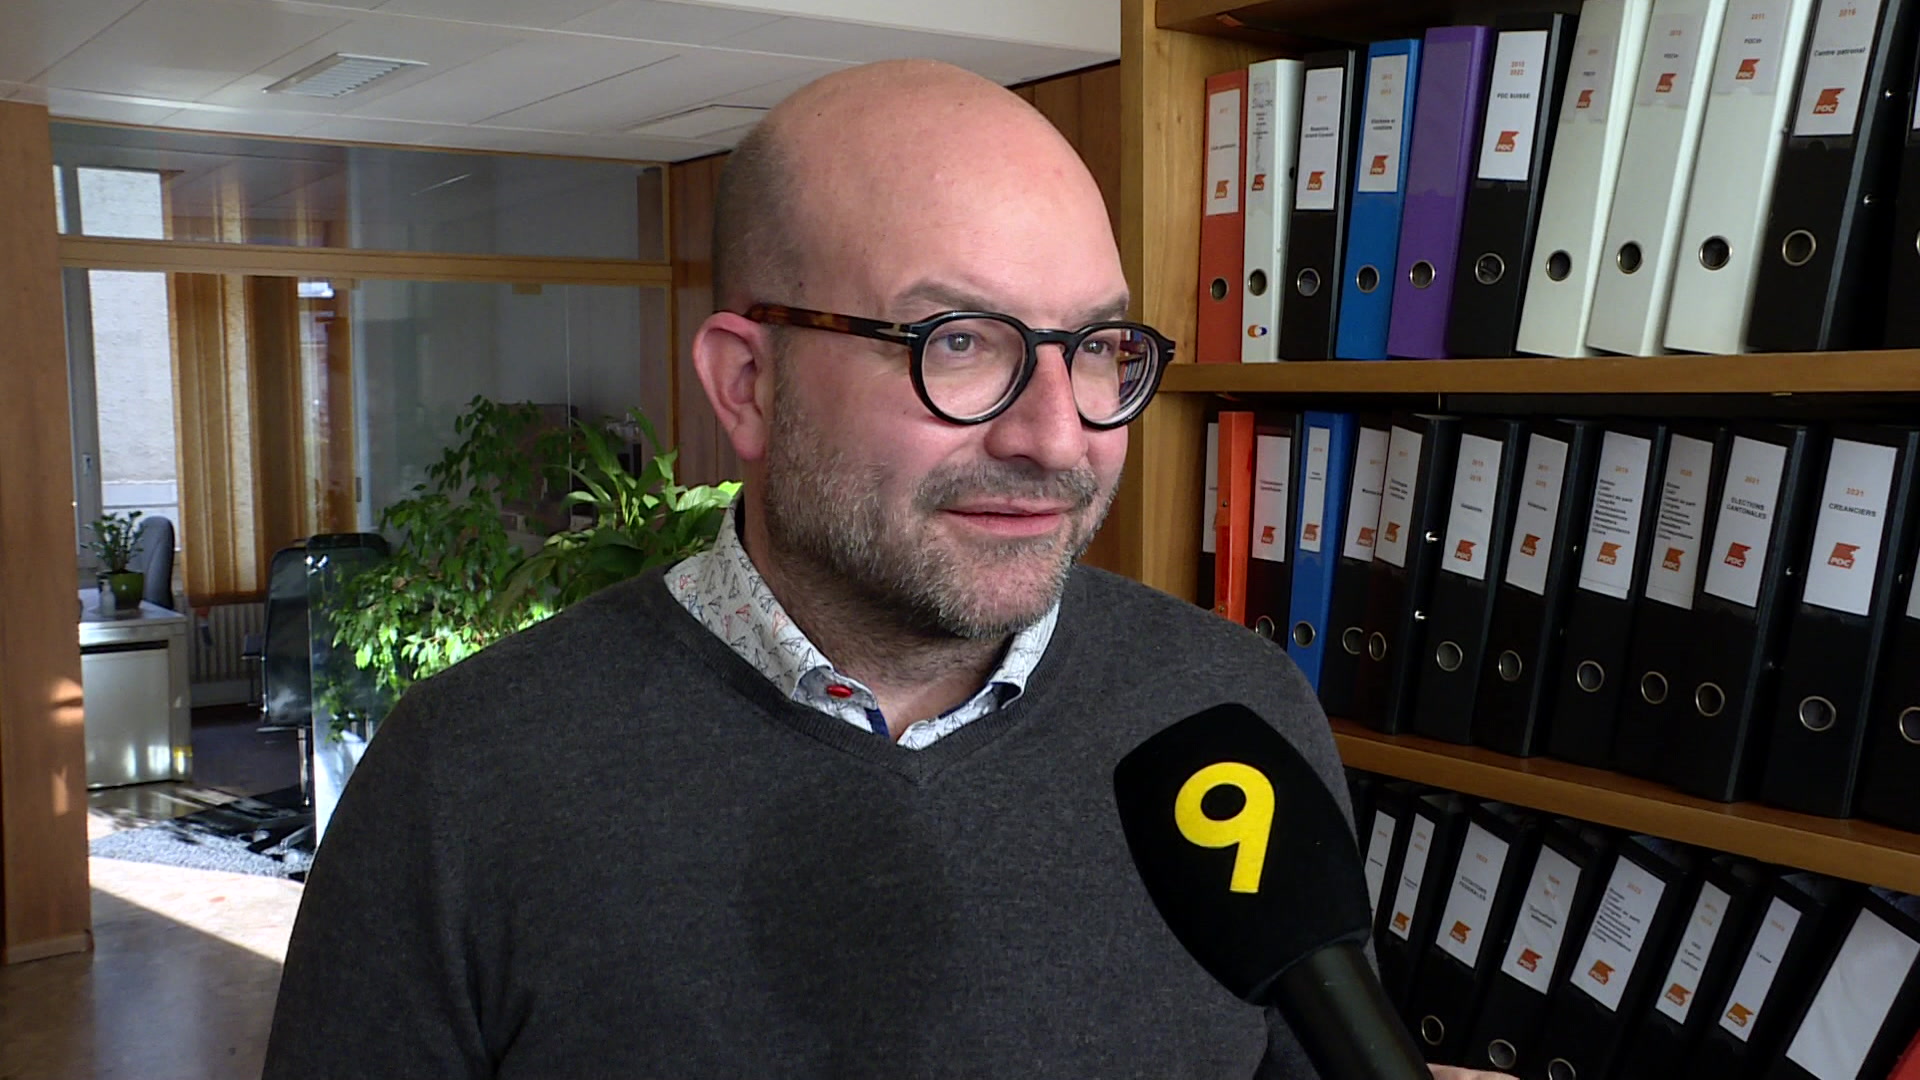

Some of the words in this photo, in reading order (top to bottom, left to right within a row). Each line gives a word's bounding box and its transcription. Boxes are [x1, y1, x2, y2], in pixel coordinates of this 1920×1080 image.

[1814, 49, 1835, 57] Centre
[1837, 47, 1867, 56] patronal
[1845, 487, 1865, 497] 2021
[1726, 504, 1767, 519] CANTONALES
[1174, 761, 1275, 893] 9
